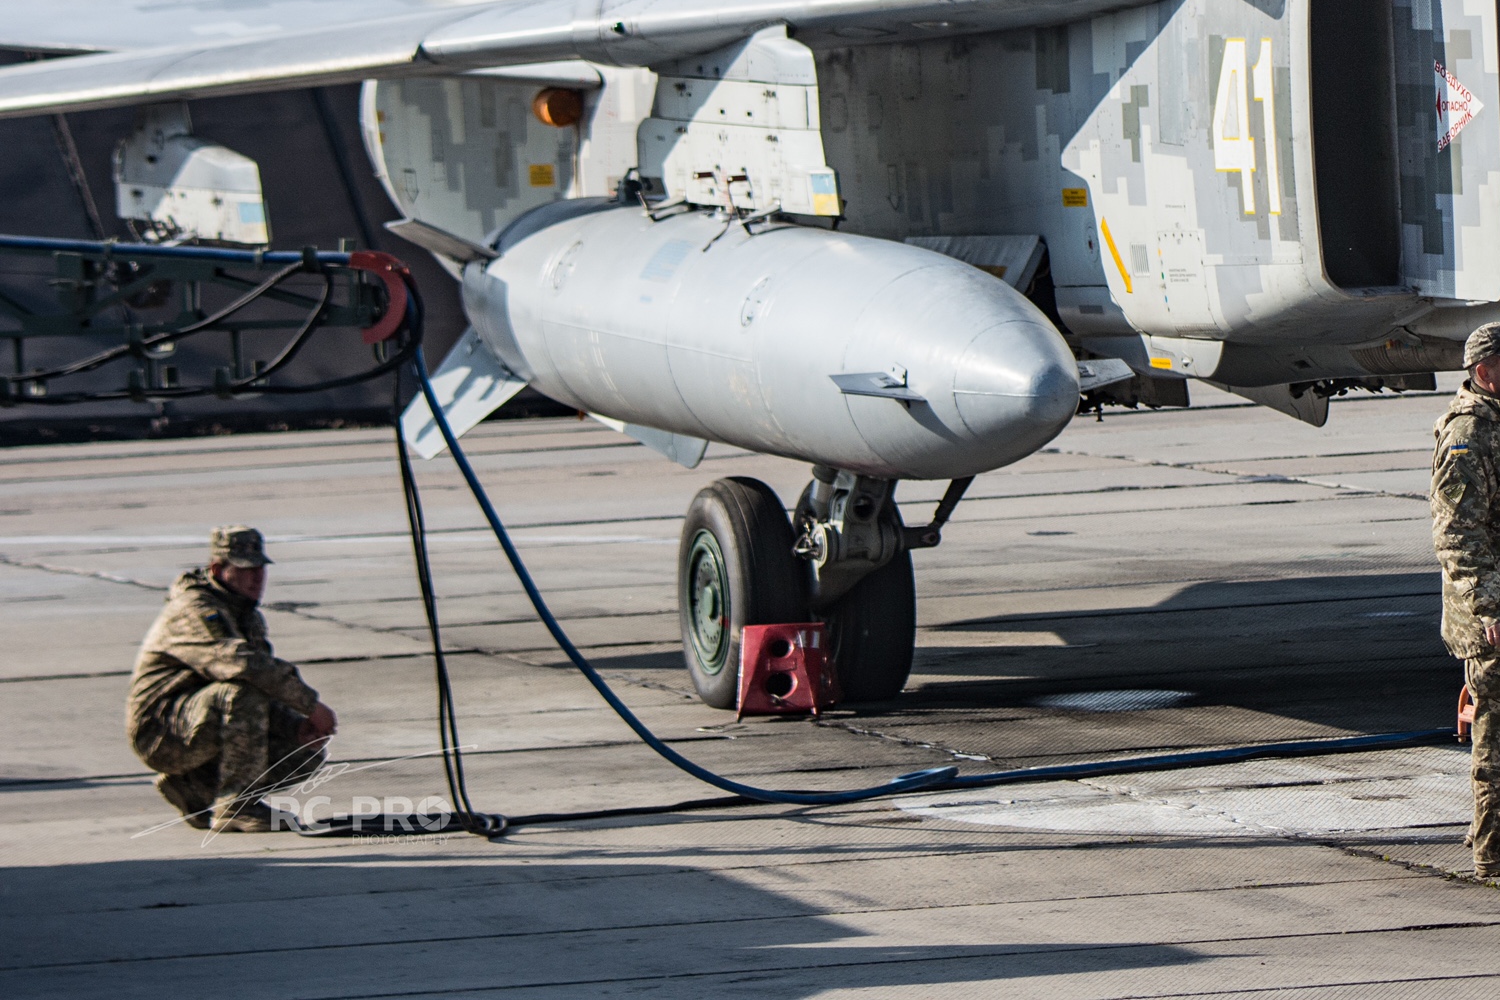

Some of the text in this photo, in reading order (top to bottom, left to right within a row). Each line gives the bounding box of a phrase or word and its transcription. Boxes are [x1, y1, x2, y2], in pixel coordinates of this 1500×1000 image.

[1435, 61, 1472, 102] ВОЗДУХО
[1213, 37, 1281, 214] 41
[1441, 101, 1468, 112] ОПАСНО
[1437, 110, 1472, 151] ЗАБОРНИК
